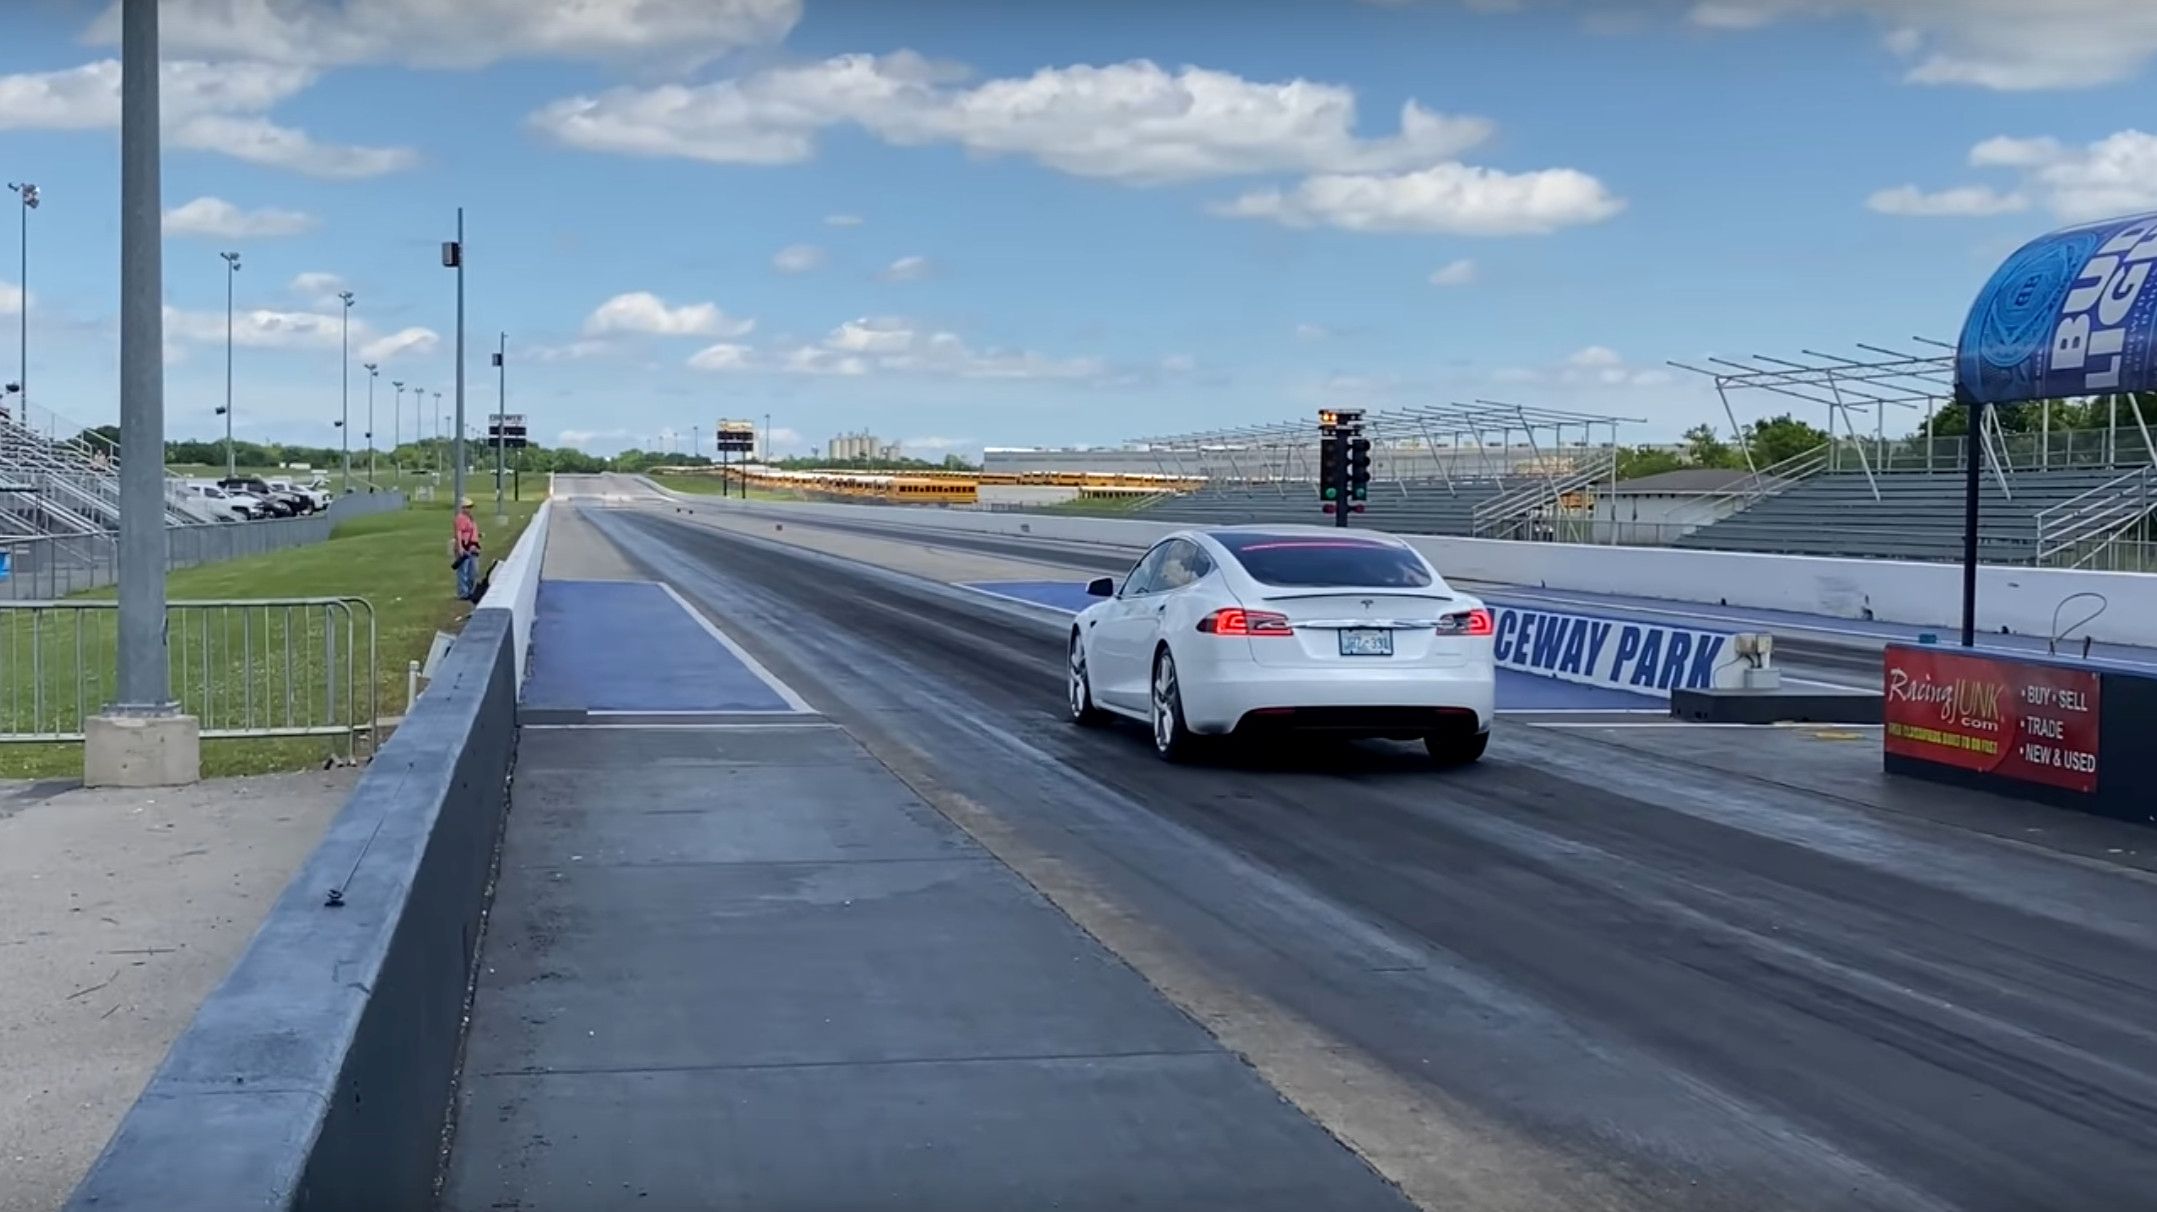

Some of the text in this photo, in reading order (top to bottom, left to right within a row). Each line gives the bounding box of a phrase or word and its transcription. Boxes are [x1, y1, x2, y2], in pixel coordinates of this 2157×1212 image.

[1489, 608, 1725, 690] CEWAY PARK
[2027, 685, 2088, 712] BUY SELL
[2026, 715, 2064, 739] TRADE
[2025, 743, 2096, 772] NEW & USED
